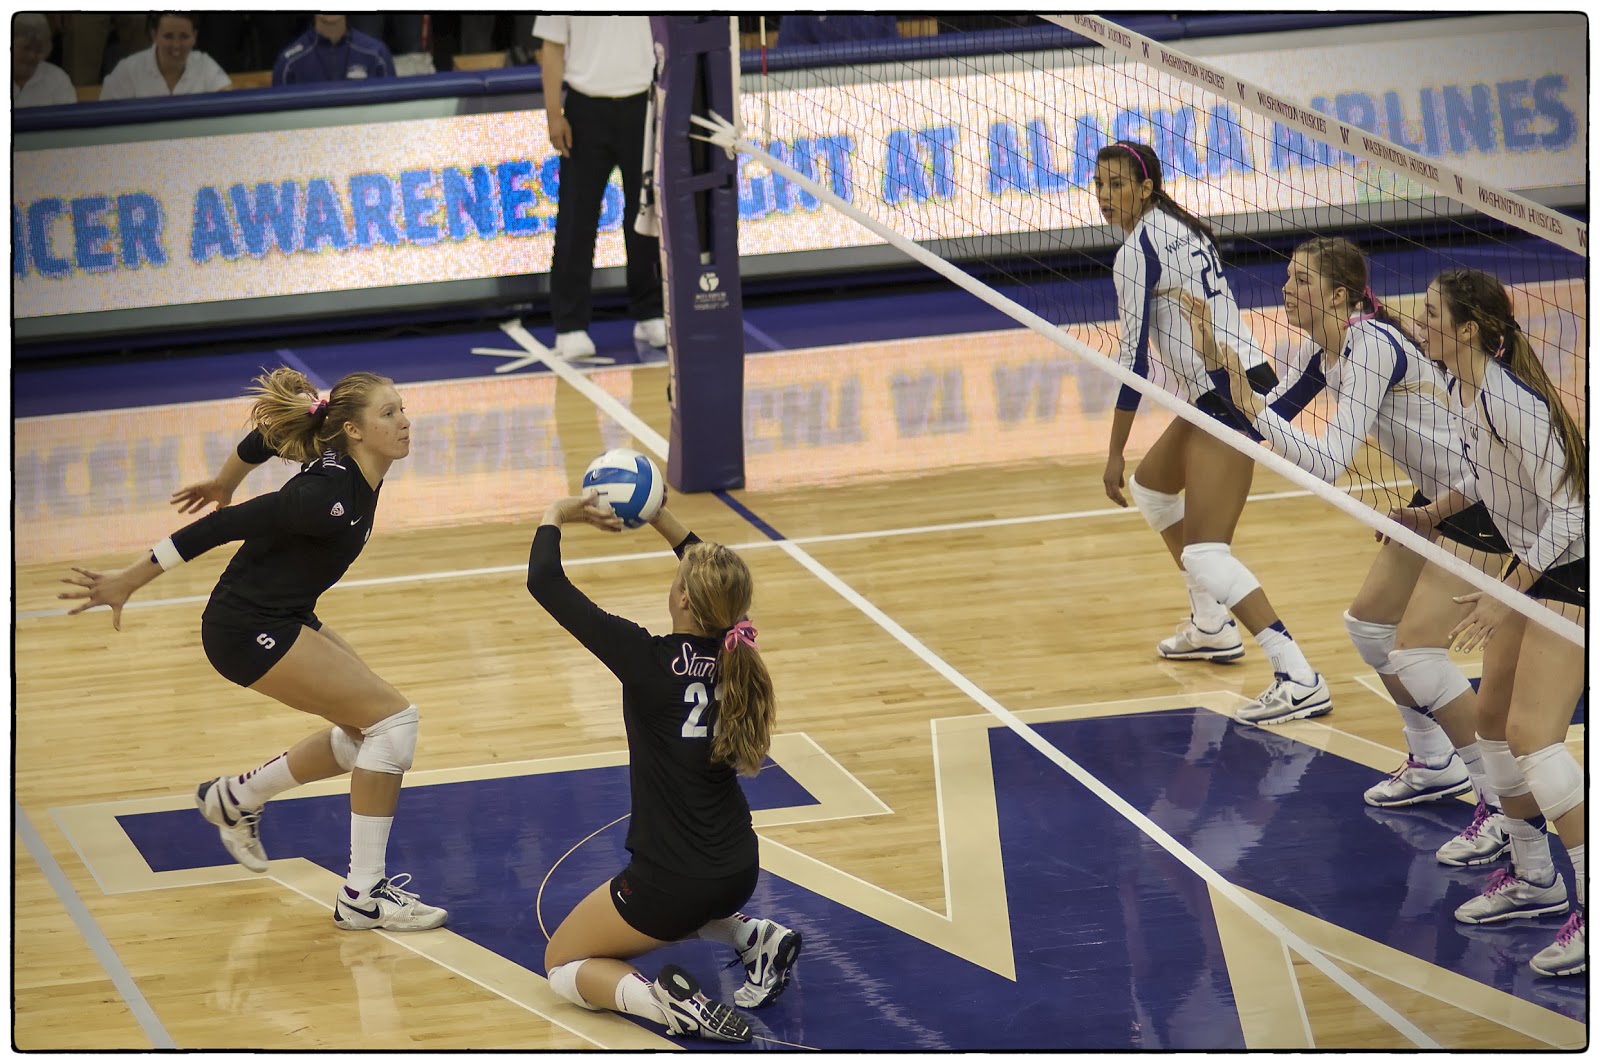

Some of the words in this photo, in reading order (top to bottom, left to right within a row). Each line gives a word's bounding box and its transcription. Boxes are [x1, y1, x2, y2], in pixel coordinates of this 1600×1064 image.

[14, 191, 167, 280] CER
[883, 125, 959, 205] AT
[987, 104, 1252, 195] ALASKA
[1160, 50, 1199, 78] WASHINGTON
[1200, 66, 1225, 90] HUSKIES
[1257, 92, 1299, 121] WASHINGTON
[1299, 111, 1327, 133] HUSKIES
[1339, 126, 1350, 146] W
[1362, 136, 1408, 167] WASHINGTON
[1409, 160, 1440, 182] HUSKIES
[1454, 174, 1464, 195] W
[1478, 186, 1526, 220] WASHINGTON
[1528, 209, 1563, 235] HUSKIES
[256, 633, 276, 650] S
[681, 682, 723, 738] 2
